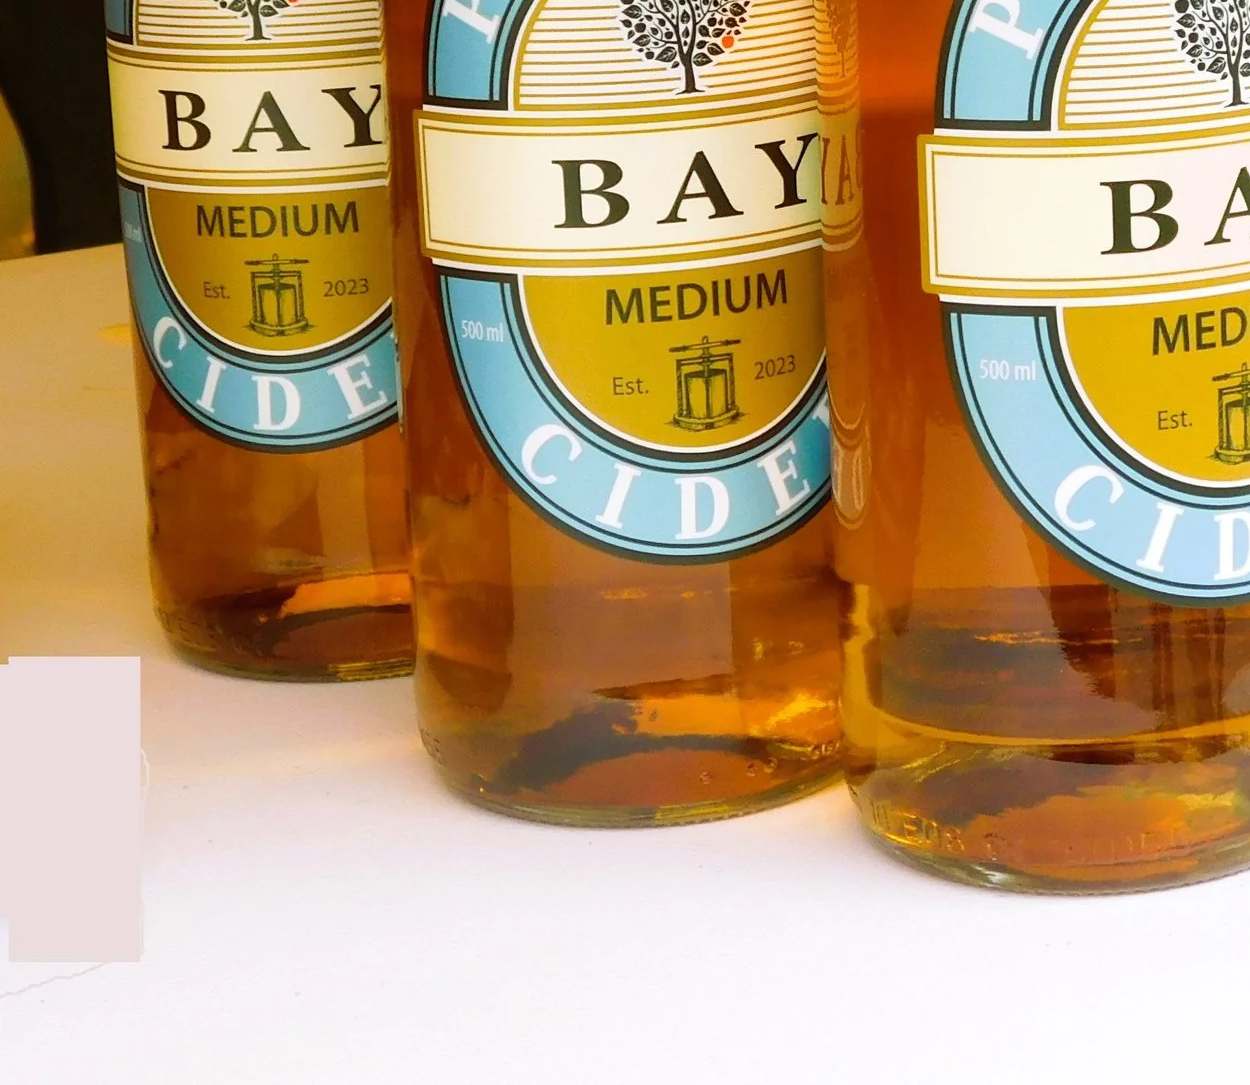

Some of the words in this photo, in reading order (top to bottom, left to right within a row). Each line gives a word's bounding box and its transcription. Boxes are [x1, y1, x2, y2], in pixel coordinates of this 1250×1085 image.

[158, 84, 383, 152] BAY
[551, 132, 819, 230] BAY
[195, 200, 360, 240] MEDIUM
[203, 280, 231, 300] Est.
[323, 277, 369, 299] 2023
[605, 269, 789, 326] MEDIUM
[461, 319, 483, 341] 500
[486, 322, 504, 343] ml
[153, 316, 395, 434] CIDE
[611, 375, 650, 397] Est.
[754, 355, 797, 379] 2023
[979, 358, 1010, 380] 500
[1014, 359, 1037, 382] ml
[1157, 409, 1193, 432] Est.
